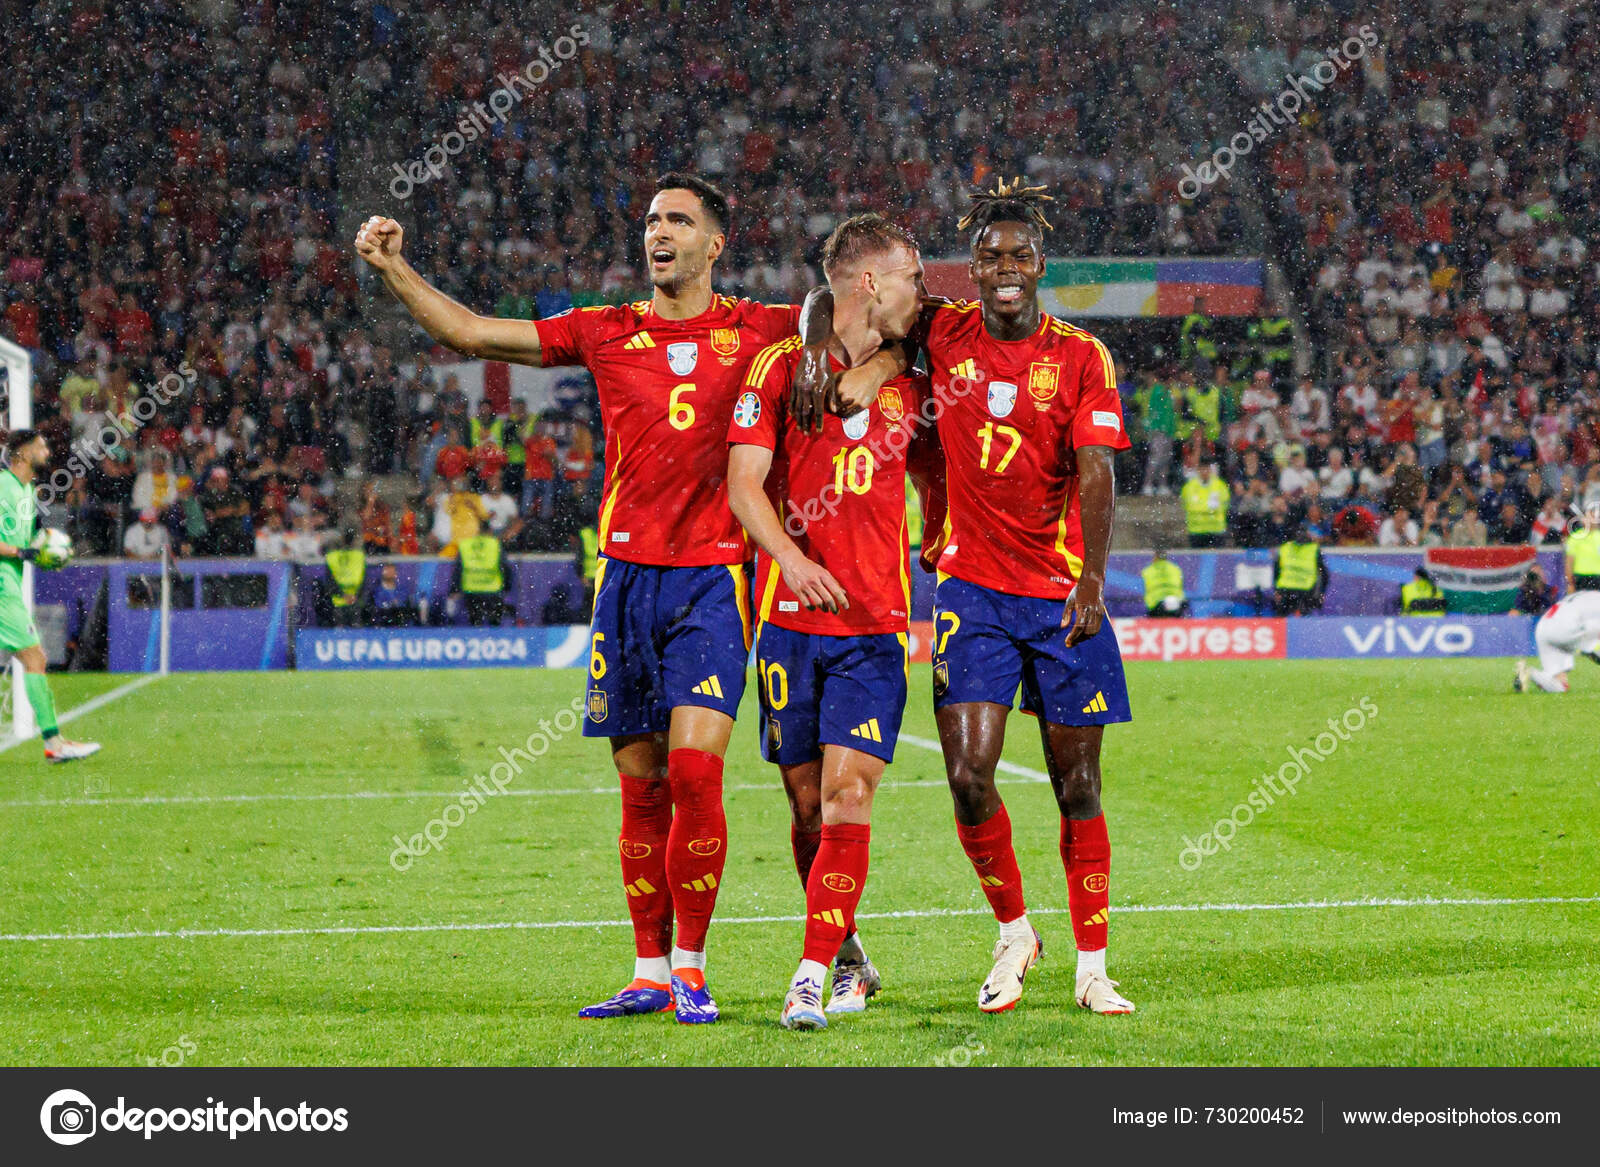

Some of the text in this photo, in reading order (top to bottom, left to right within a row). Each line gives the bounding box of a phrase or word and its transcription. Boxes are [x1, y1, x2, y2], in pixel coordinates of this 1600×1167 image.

[669, 384, 696, 431] 6
[833, 446, 874, 495] 10
[977, 421, 1022, 473] 17
[590, 631, 607, 680] 6
[1115, 618, 1275, 661] Express
[1343, 618, 1474, 653] vivo
